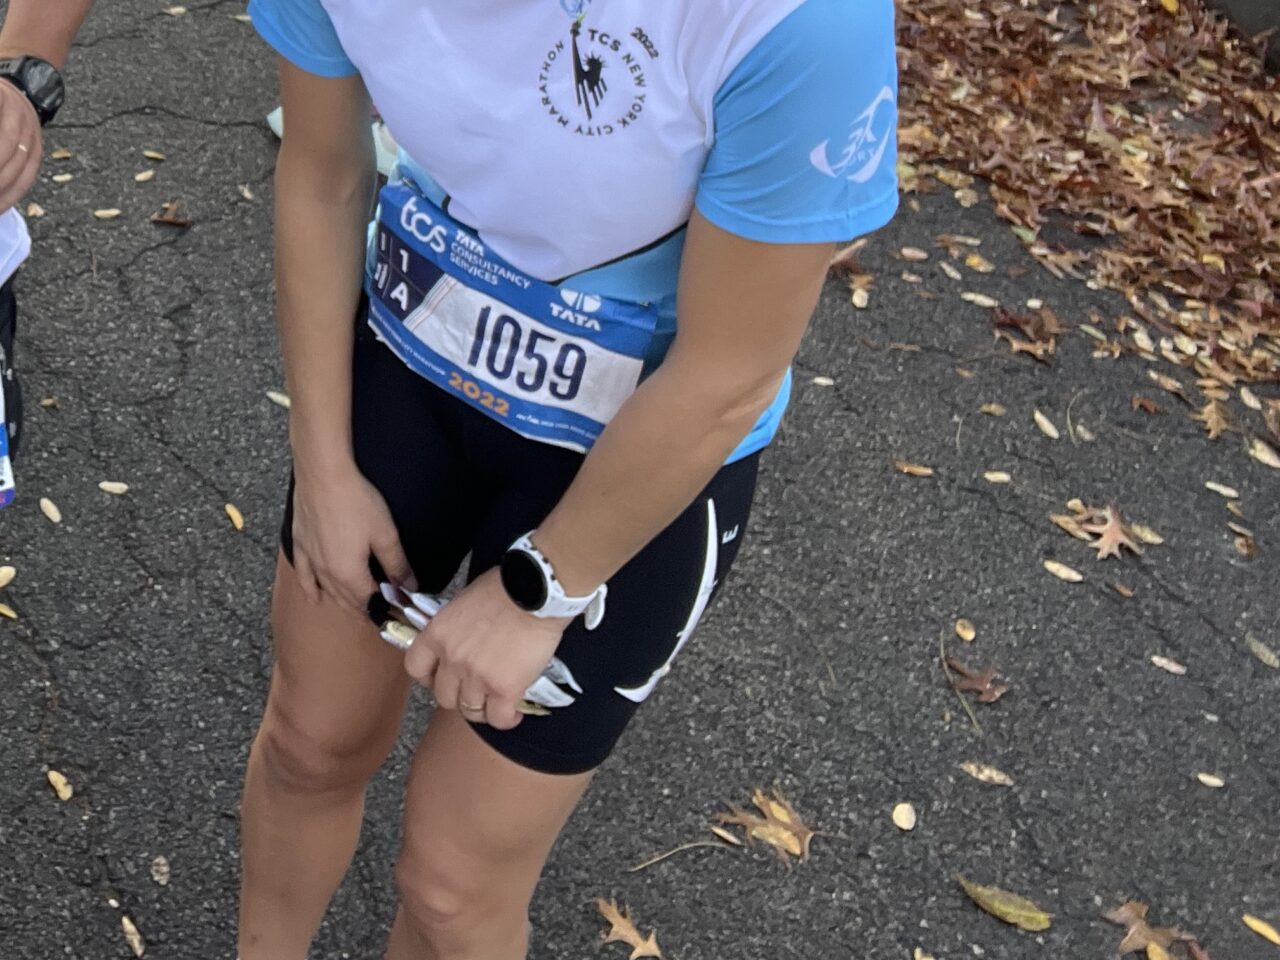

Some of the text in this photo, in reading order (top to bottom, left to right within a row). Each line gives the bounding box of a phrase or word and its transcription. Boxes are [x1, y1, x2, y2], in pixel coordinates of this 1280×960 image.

[630, 27, 659, 60] 2022
[539, 28, 646, 136] TCS NEW YORK CITY MARATHON
[455, 229, 485, 257] TATA
[400, 248, 409, 273] 1
[450, 252, 499, 286] SERVICES
[451, 242, 532, 289] CONSULTANCY
[390, 281, 409, 312] A
[549, 302, 601, 332] TATA
[468, 304, 587, 401] 1059
[448, 371, 510, 418] 2022
